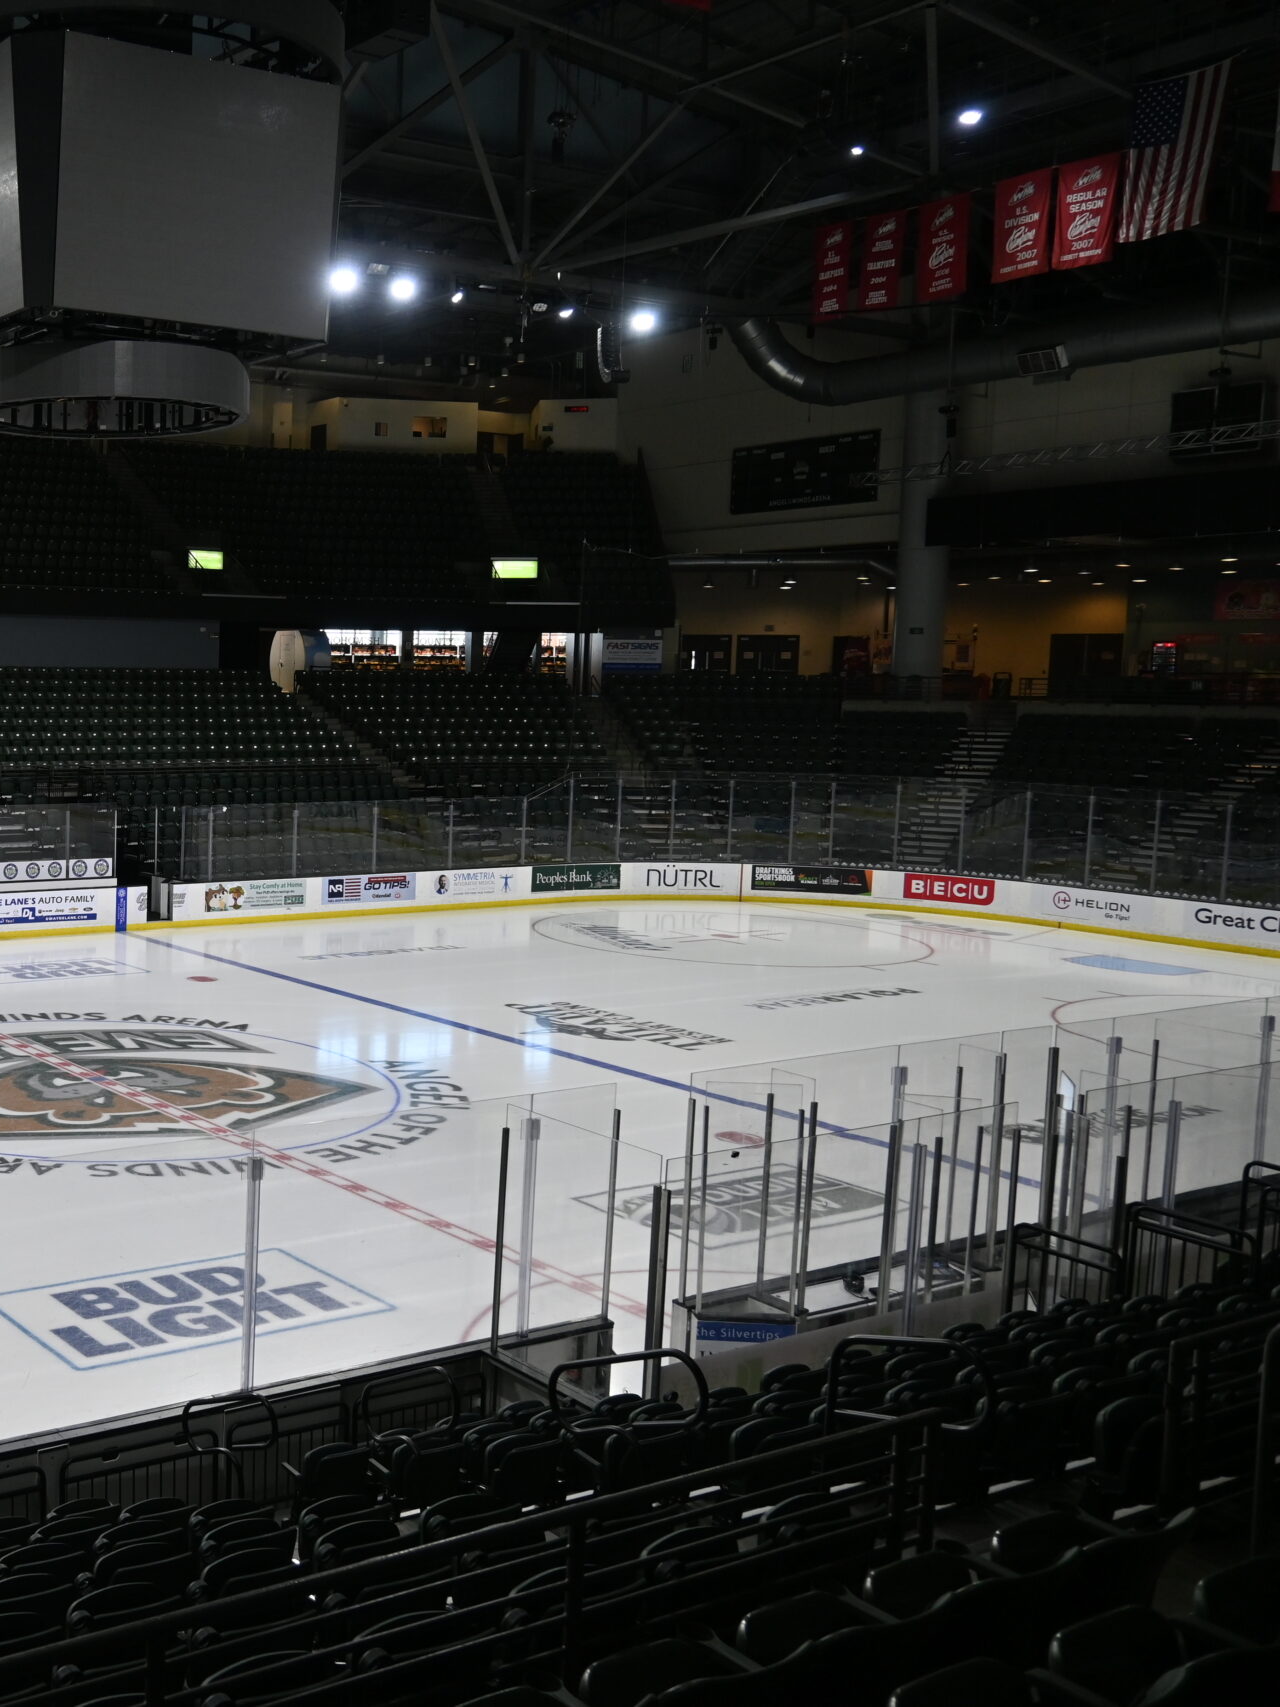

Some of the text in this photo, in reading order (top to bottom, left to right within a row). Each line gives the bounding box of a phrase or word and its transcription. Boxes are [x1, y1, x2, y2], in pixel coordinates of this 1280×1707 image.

[1066, 188, 1107, 203] REGULAR
[1016, 205, 1029, 215] U.S.
[1069, 201, 1104, 214] SEASON
[1004, 212, 1040, 229] DIVISION
[1071, 238, 1094, 250] 2007
[1016, 249, 1037, 261] 2007
[607, 642, 660, 650] FASTSIGNS
[453, 871, 496, 882] SYMMETRIA
[536, 870, 592, 884] Peoples Bank
[755, 867, 793, 876] DRAFTKINGS
[755, 873, 796, 882] SPORTSBOOK
[249, 883, 262, 891] Stay
[364, 880, 410, 891] GO TIPS!
[4, 897, 36, 906] LANE'S
[38, 896, 63, 905] AUTO
[64, 894, 95, 903] FAMILY
[1074, 897, 1131, 913] HELION
[1115, 913, 1130, 921] Tips!
[1194, 907, 1256, 930] Great
[12, 966, 117, 980] BUD
[744, 987, 922, 1011] POLARBEAR
[121, 1013, 249, 1032] ARENA
[504, 1002, 712, 1051] TULALIP
[550, 1001, 734, 1045] RESORT CASINO
[50, 1265, 266, 1320] BUD
[50, 1281, 350, 1358] LIGHT
[720, 1328, 780, 1341] Silvertips
